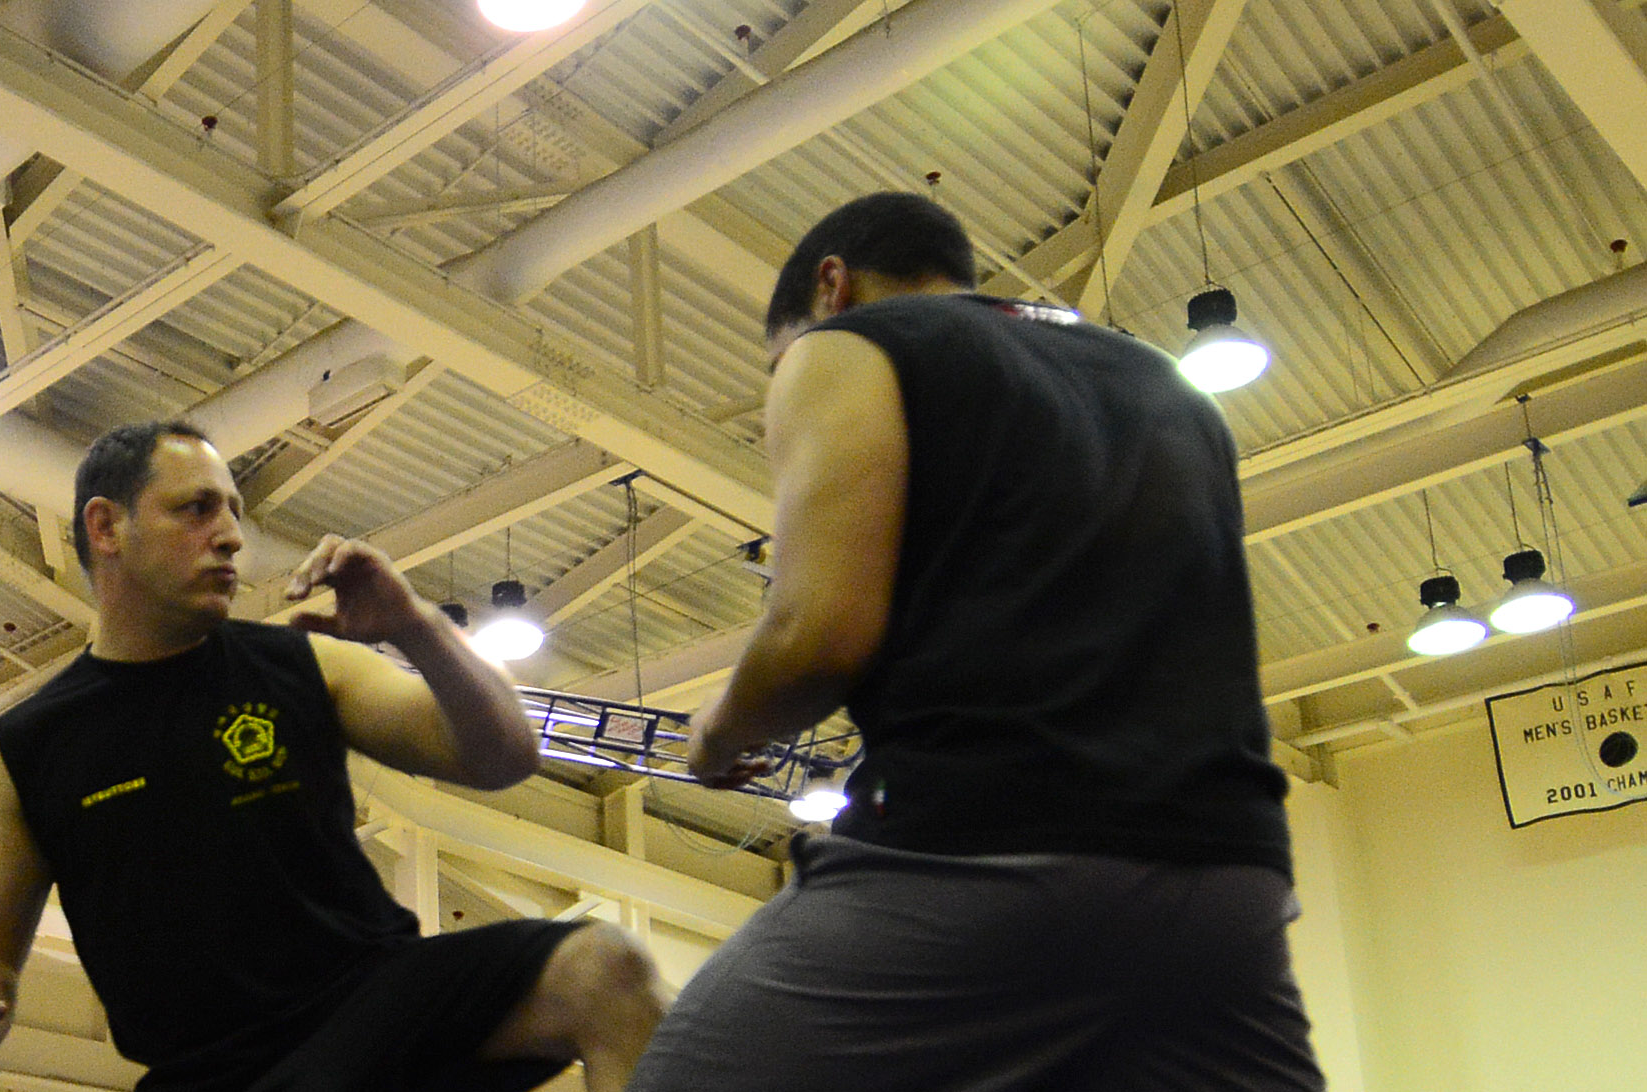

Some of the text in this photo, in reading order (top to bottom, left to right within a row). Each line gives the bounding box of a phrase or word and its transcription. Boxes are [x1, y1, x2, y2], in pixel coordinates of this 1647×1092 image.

[1523, 703, 1647, 744] MEN'S BASKE
[1546, 782, 1598, 804] 2001
